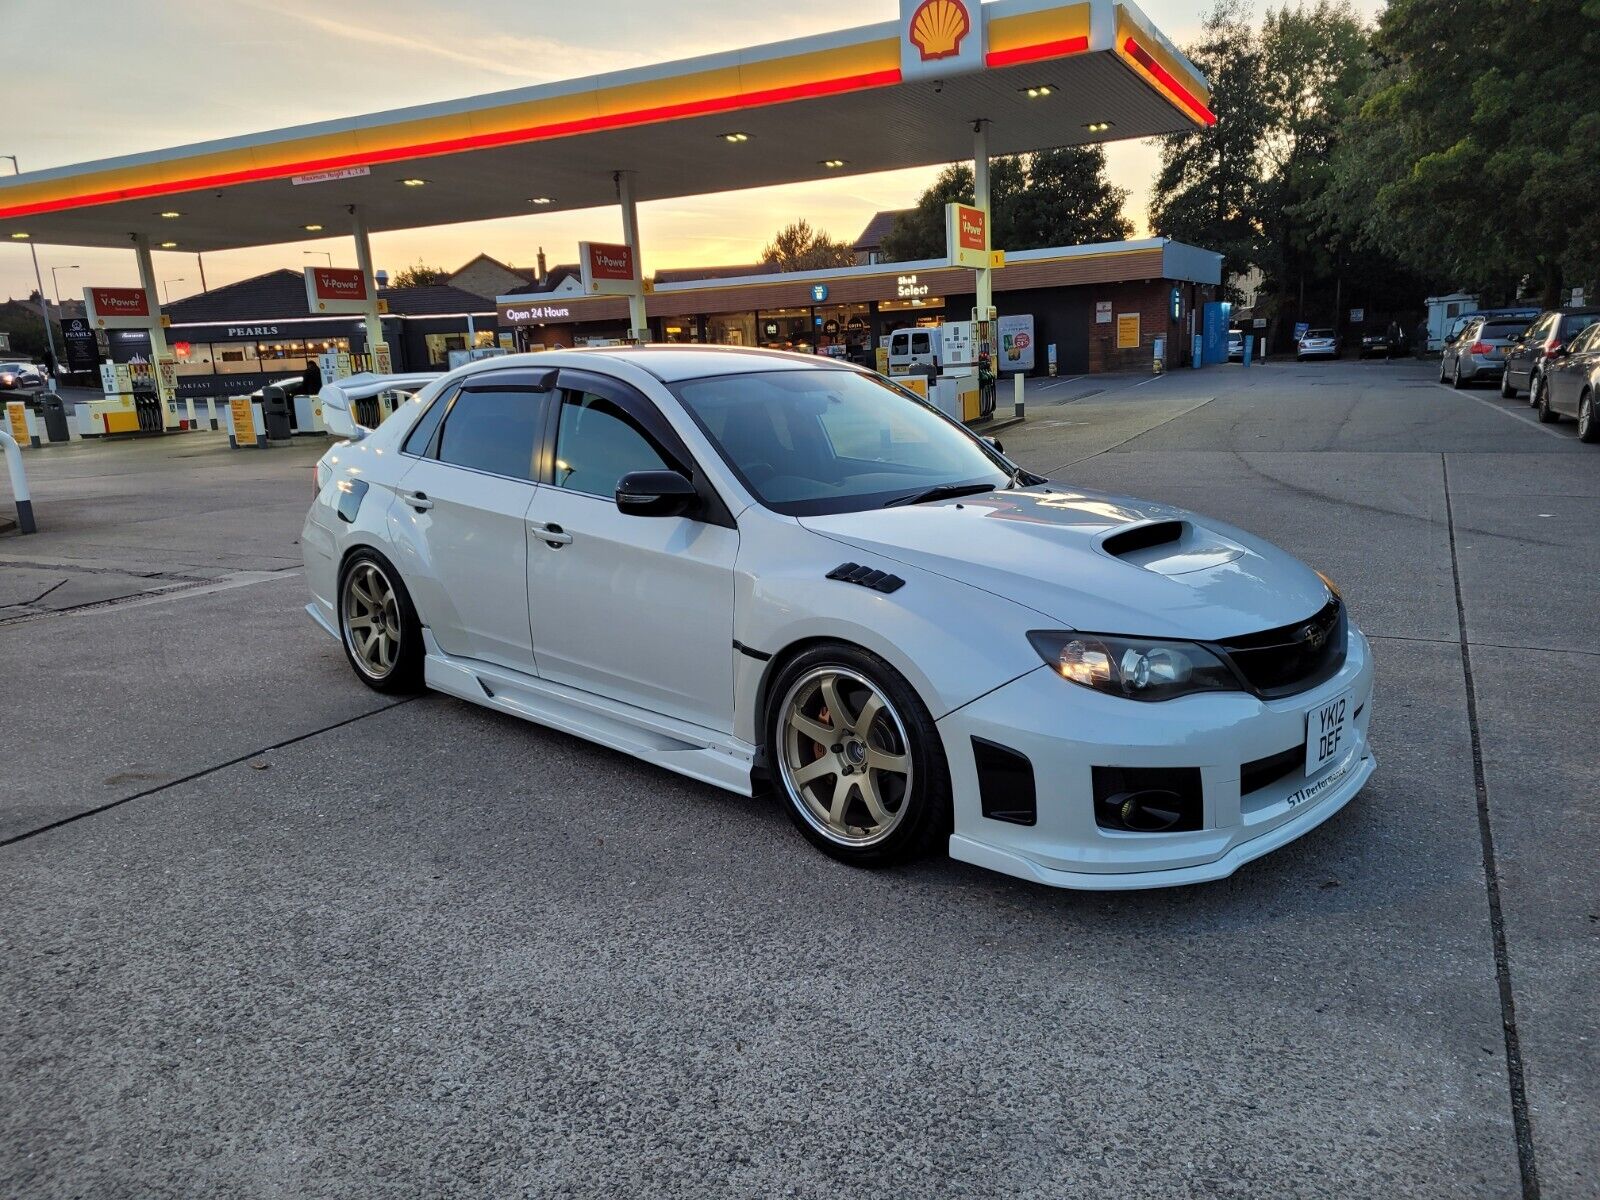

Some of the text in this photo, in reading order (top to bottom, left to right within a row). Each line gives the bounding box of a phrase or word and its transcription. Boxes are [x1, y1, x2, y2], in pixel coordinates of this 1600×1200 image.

[596, 256, 626, 268] V-Power
[322, 279, 358, 289] V-Power
[898, 275, 917, 285] Shell
[898, 285, 929, 297] Select
[102, 298, 139, 306] V-Power
[506, 306, 569, 321] Open 24 Hours
[228, 326, 279, 337] PEARLS
[224, 380, 254, 388] LUNCH
[1320, 699, 1346, 733] YK12
[1319, 726, 1343, 762] DEF
[1287, 768, 1347, 809] STI Performance
